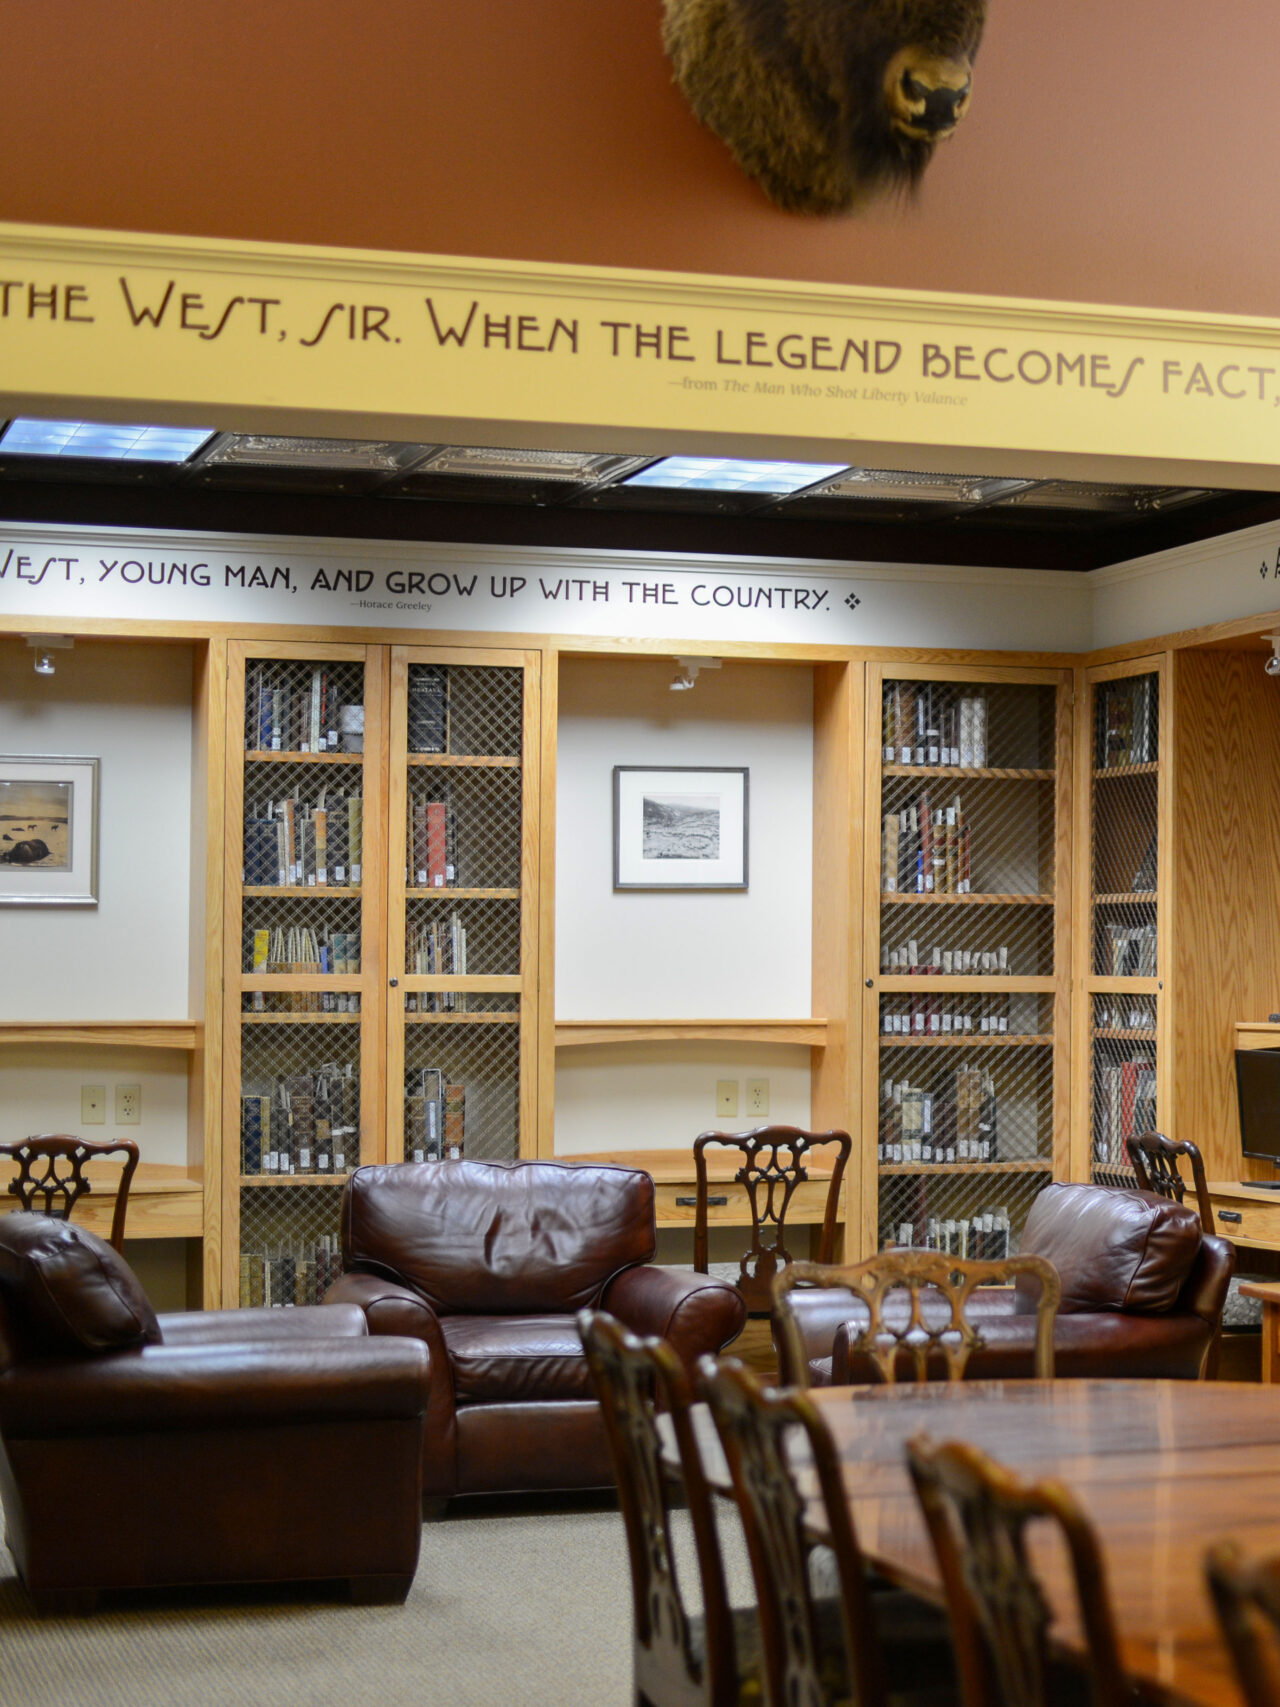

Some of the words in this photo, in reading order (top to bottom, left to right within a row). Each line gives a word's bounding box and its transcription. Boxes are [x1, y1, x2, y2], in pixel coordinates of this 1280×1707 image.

[118, 276, 287, 342] WEST,
[299, 302, 402, 347] SIR.
[425, 297, 579, 354] WHEN
[600, 320, 696, 362] THE
[716, 328, 902, 375] LEGEND
[921, 342, 1145, 398] BECOMES
[722, 378, 750, 393] The
[753, 381, 785, 396] Man
[790, 383, 823, 398] Who
[825, 385, 859, 401] Shot
[861, 387, 911, 406] Liberty
[914, 391, 969, 407] Valance
[98, 558, 212, 588] YOUNG
[224, 565, 298, 594] MAN,
[309, 567, 375, 593] AND
[385, 571, 479, 597] GROW
[489, 576, 527, 598] UP
[538, 578, 610, 602] WITH
[621, 582, 679, 606] THE
[690, 584, 831, 611] COUNTRY.
[396, 600, 432, 613] Greeley
